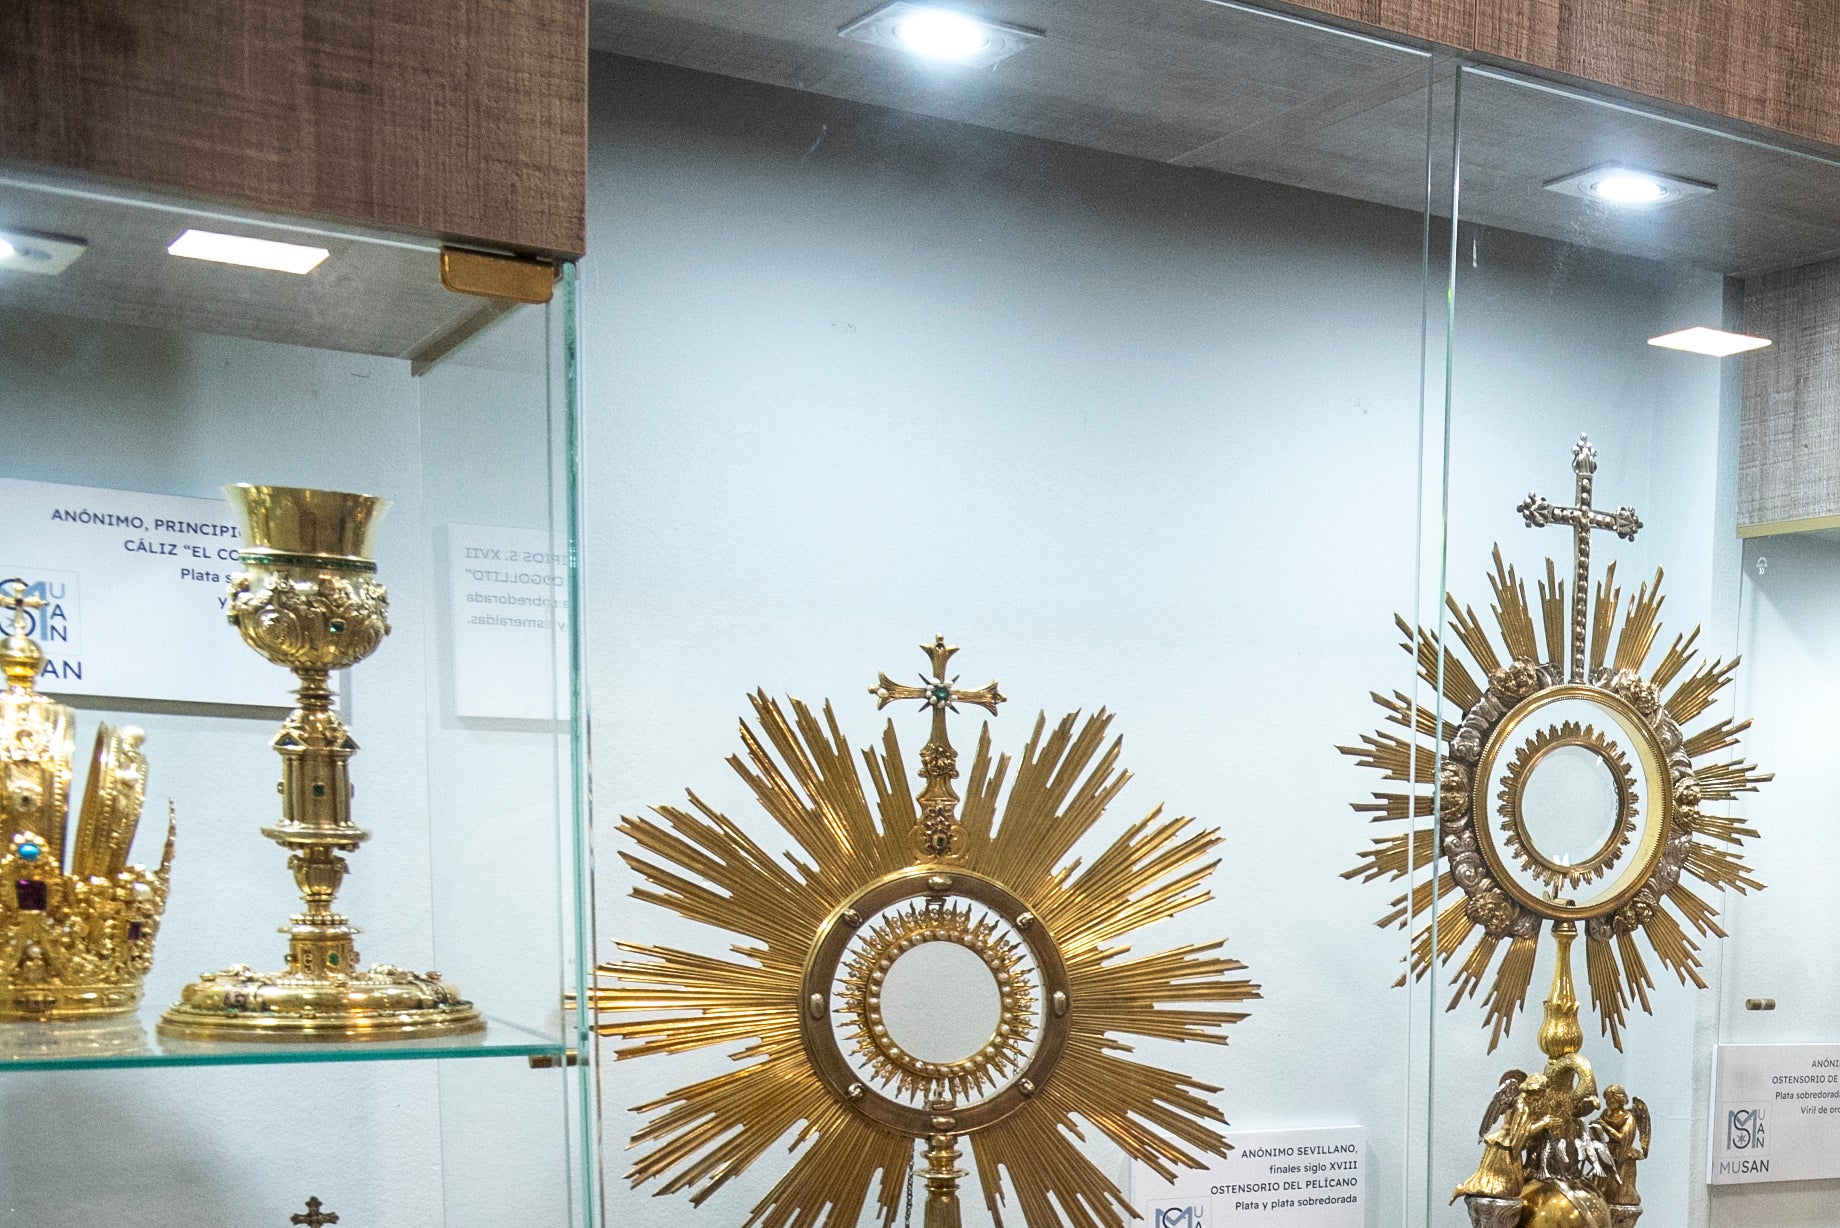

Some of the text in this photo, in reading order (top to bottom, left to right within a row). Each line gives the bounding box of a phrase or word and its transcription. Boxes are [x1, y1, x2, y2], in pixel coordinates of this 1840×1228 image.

[51, 508, 241, 538] ANÓNIMO, PRINCIPI
[124, 538, 178, 556] CÁLIZ
[180, 568, 220, 583] Plata
[1771, 1075, 1826, 1084] OSTENSORIO
[1827, 1074, 1838, 1083] DE
[1775, 1091, 1794, 1100] Plata
[1817, 1105, 1828, 1114] de
[1241, 1144, 1358, 1159] ANÓNIMO SEVILLANO,
[1269, 1161, 1358, 1175] finales siglo XVIII
[1719, 1159, 1770, 1175] MUSAN
[1210, 1177, 1358, 1195] OSTENSORIO DEL PELÍCANO
[1235, 1194, 1358, 1211] Plata y plata sobredorada
